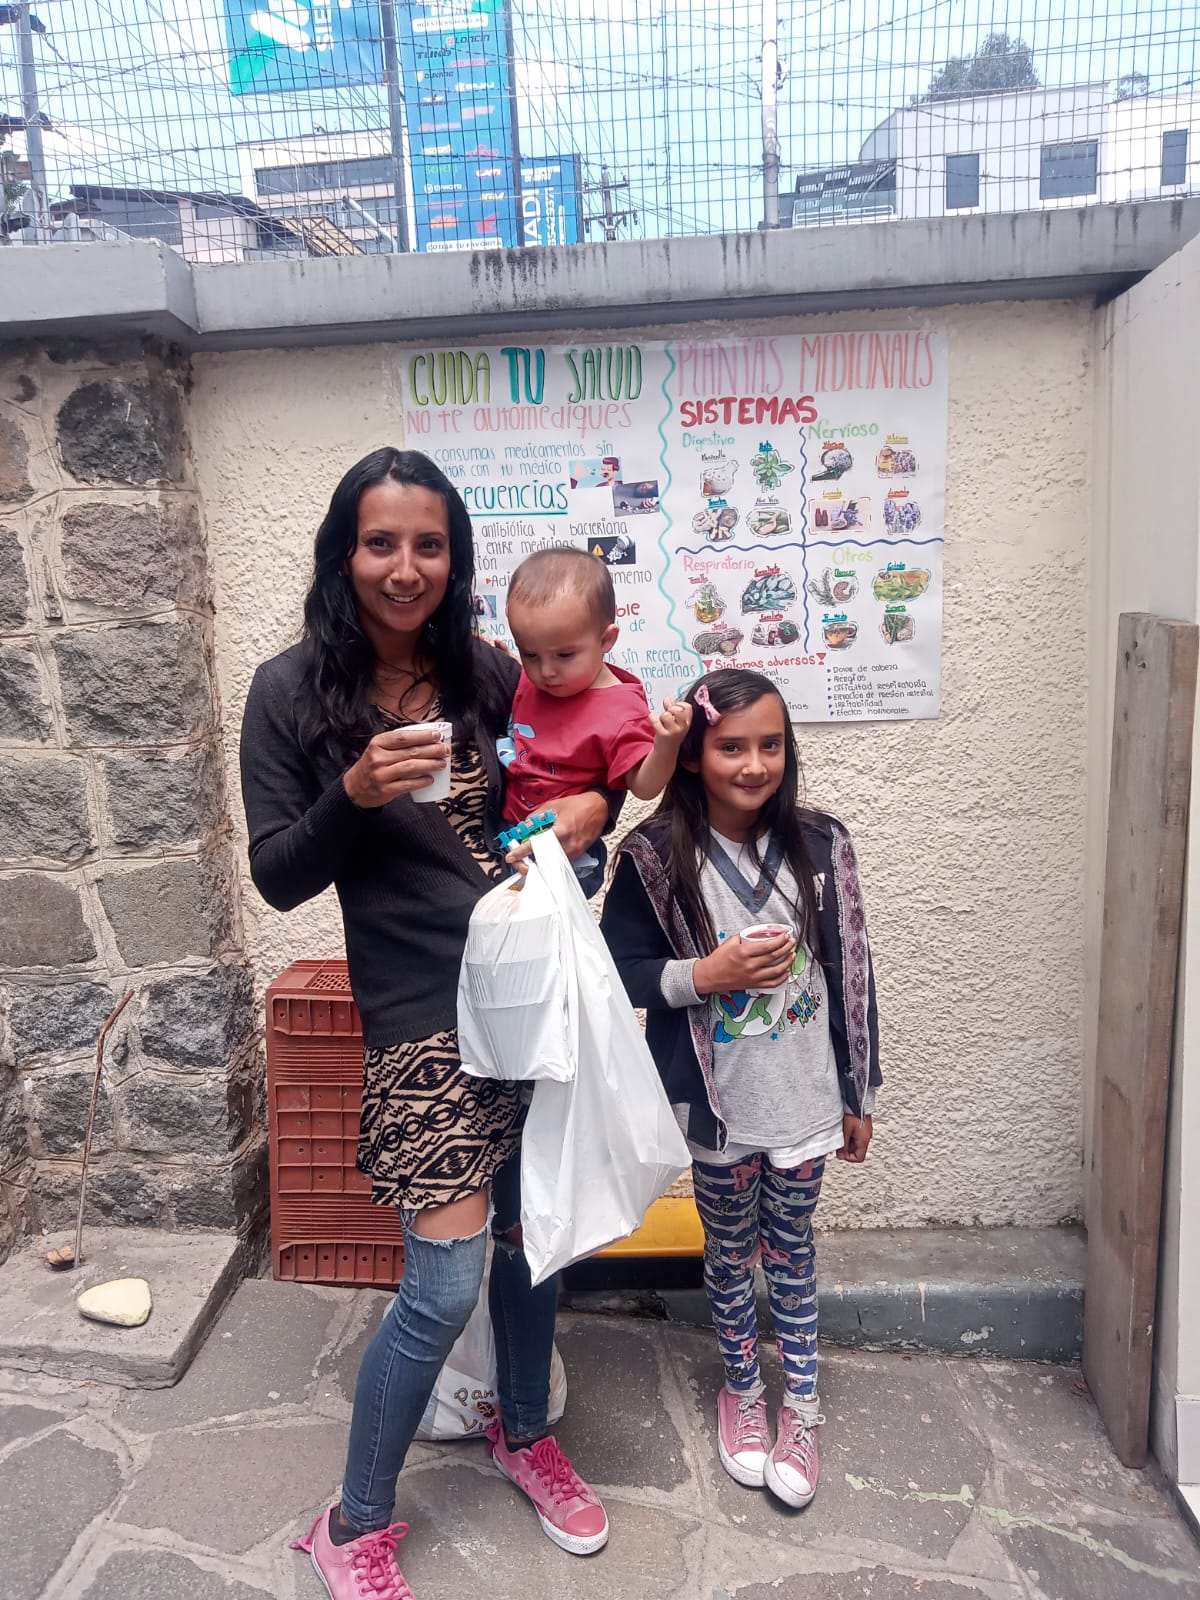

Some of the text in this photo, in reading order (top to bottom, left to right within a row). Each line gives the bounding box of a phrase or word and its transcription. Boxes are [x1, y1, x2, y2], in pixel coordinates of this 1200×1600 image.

[676, 332, 938, 396] PLANTAS MEDICINALES
[409, 345, 642, 406] CUIDA TU SALUD
[438, 409, 463, 433] te
[474, 401, 633, 439] automediques
[680, 395, 817, 428] SISTEMAS
[809, 419, 878, 440] Nervioso
[682, 431, 735, 452] Digestivo
[434, 447, 496, 462] consumas
[504, 441, 586, 459] medicamentos
[596, 440, 613, 457] sin
[471, 464, 489, 477] con
[501, 464, 513, 477] tu
[520, 459, 561, 475] médico
[462, 480, 568, 510] ecuencias
[482, 520, 535, 538] antibiótica
[548, 523, 556, 535] y
[683, 555, 755, 574] Respiratorio
[832, 547, 872, 565] Otros
[630, 619, 645, 632] de
[622, 648, 638, 664] sin
[768, 655, 816, 667] adversos
[641, 664, 695, 679] medicinas
[857, 665, 868, 673] de
[872, 664, 898, 672] cabeza
[866, 691, 874, 699] de
